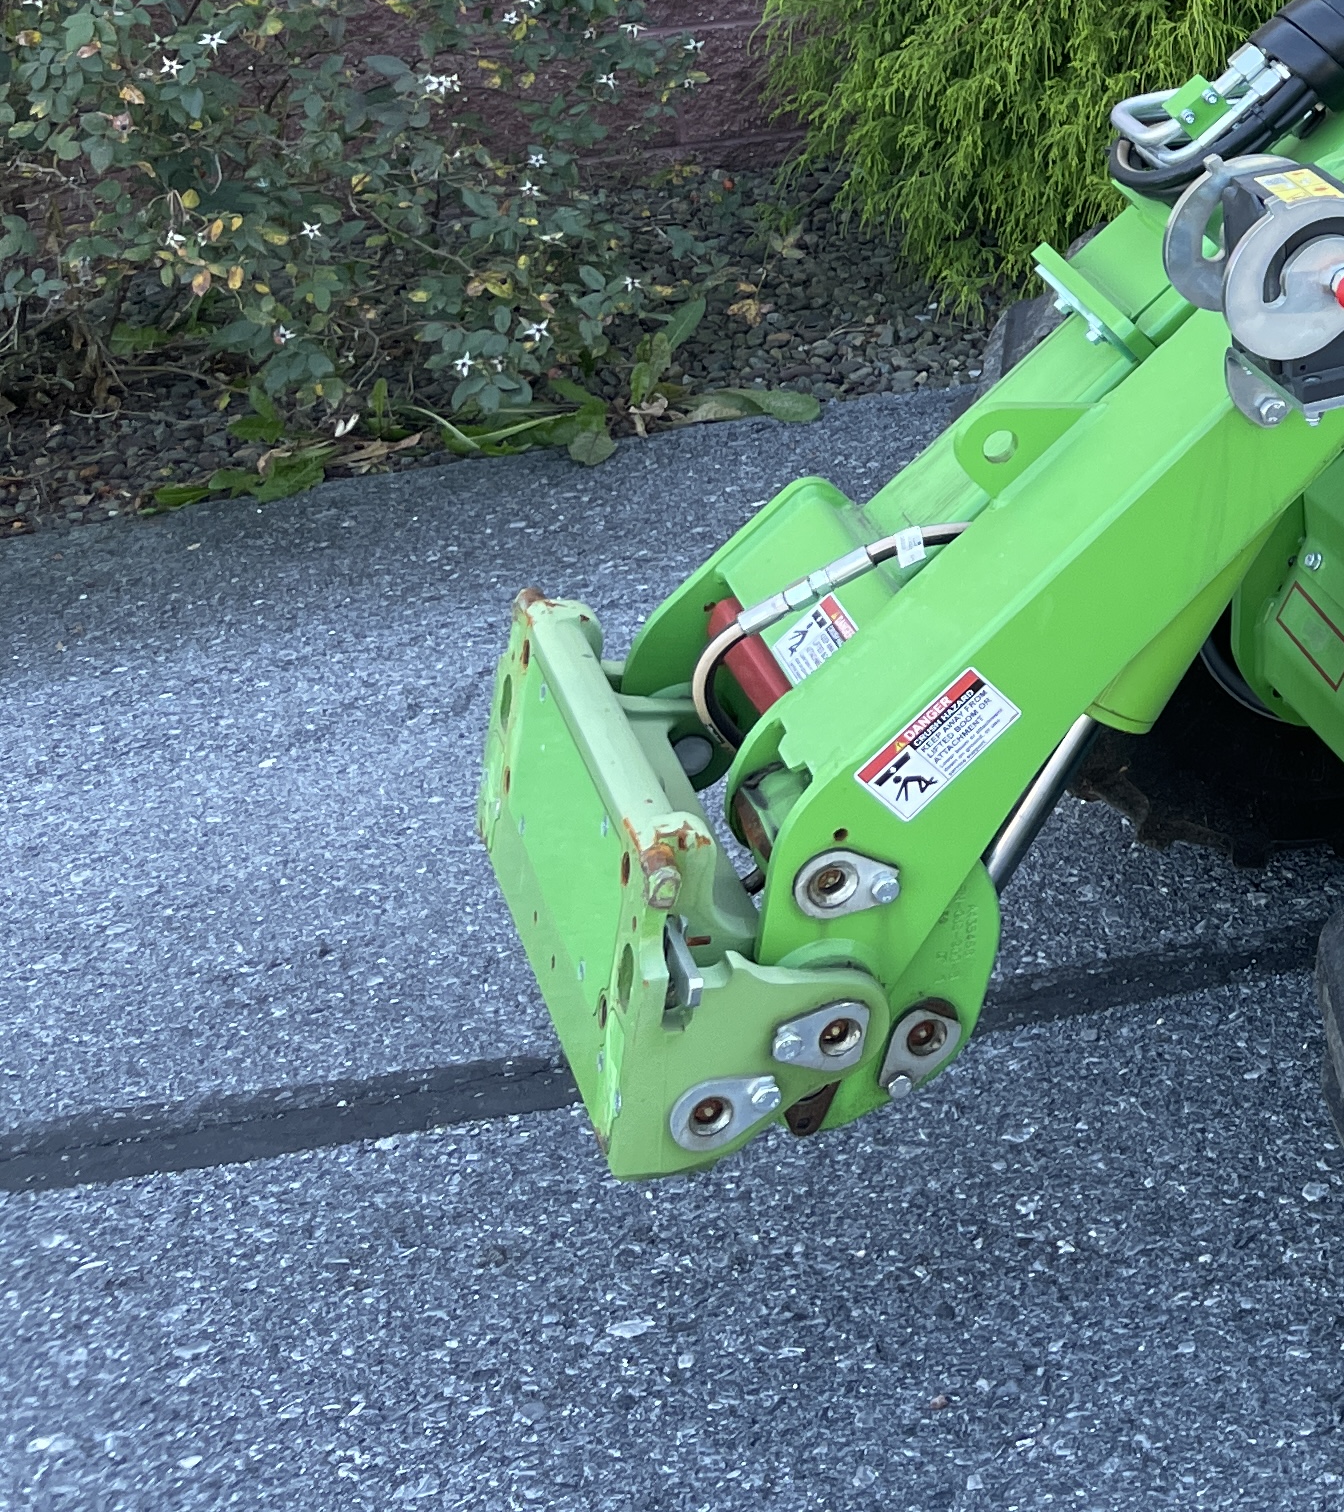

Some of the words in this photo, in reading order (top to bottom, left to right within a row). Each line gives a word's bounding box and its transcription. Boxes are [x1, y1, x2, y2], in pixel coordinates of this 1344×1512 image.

[903, 696, 952, 742] DANGER
[913, 719, 942, 746] CRUSH
[941, 689, 974, 721] HAZARD
[921, 732, 941, 753] KEEP
[943, 710, 964, 733] AWAY
[964, 690, 988, 712] FROM
[927, 732, 954, 759] LIFTED
[954, 709, 978, 733] BOOM
[978, 697, 992, 710] OR
[934, 715, 984, 764] ATTACHMENT
